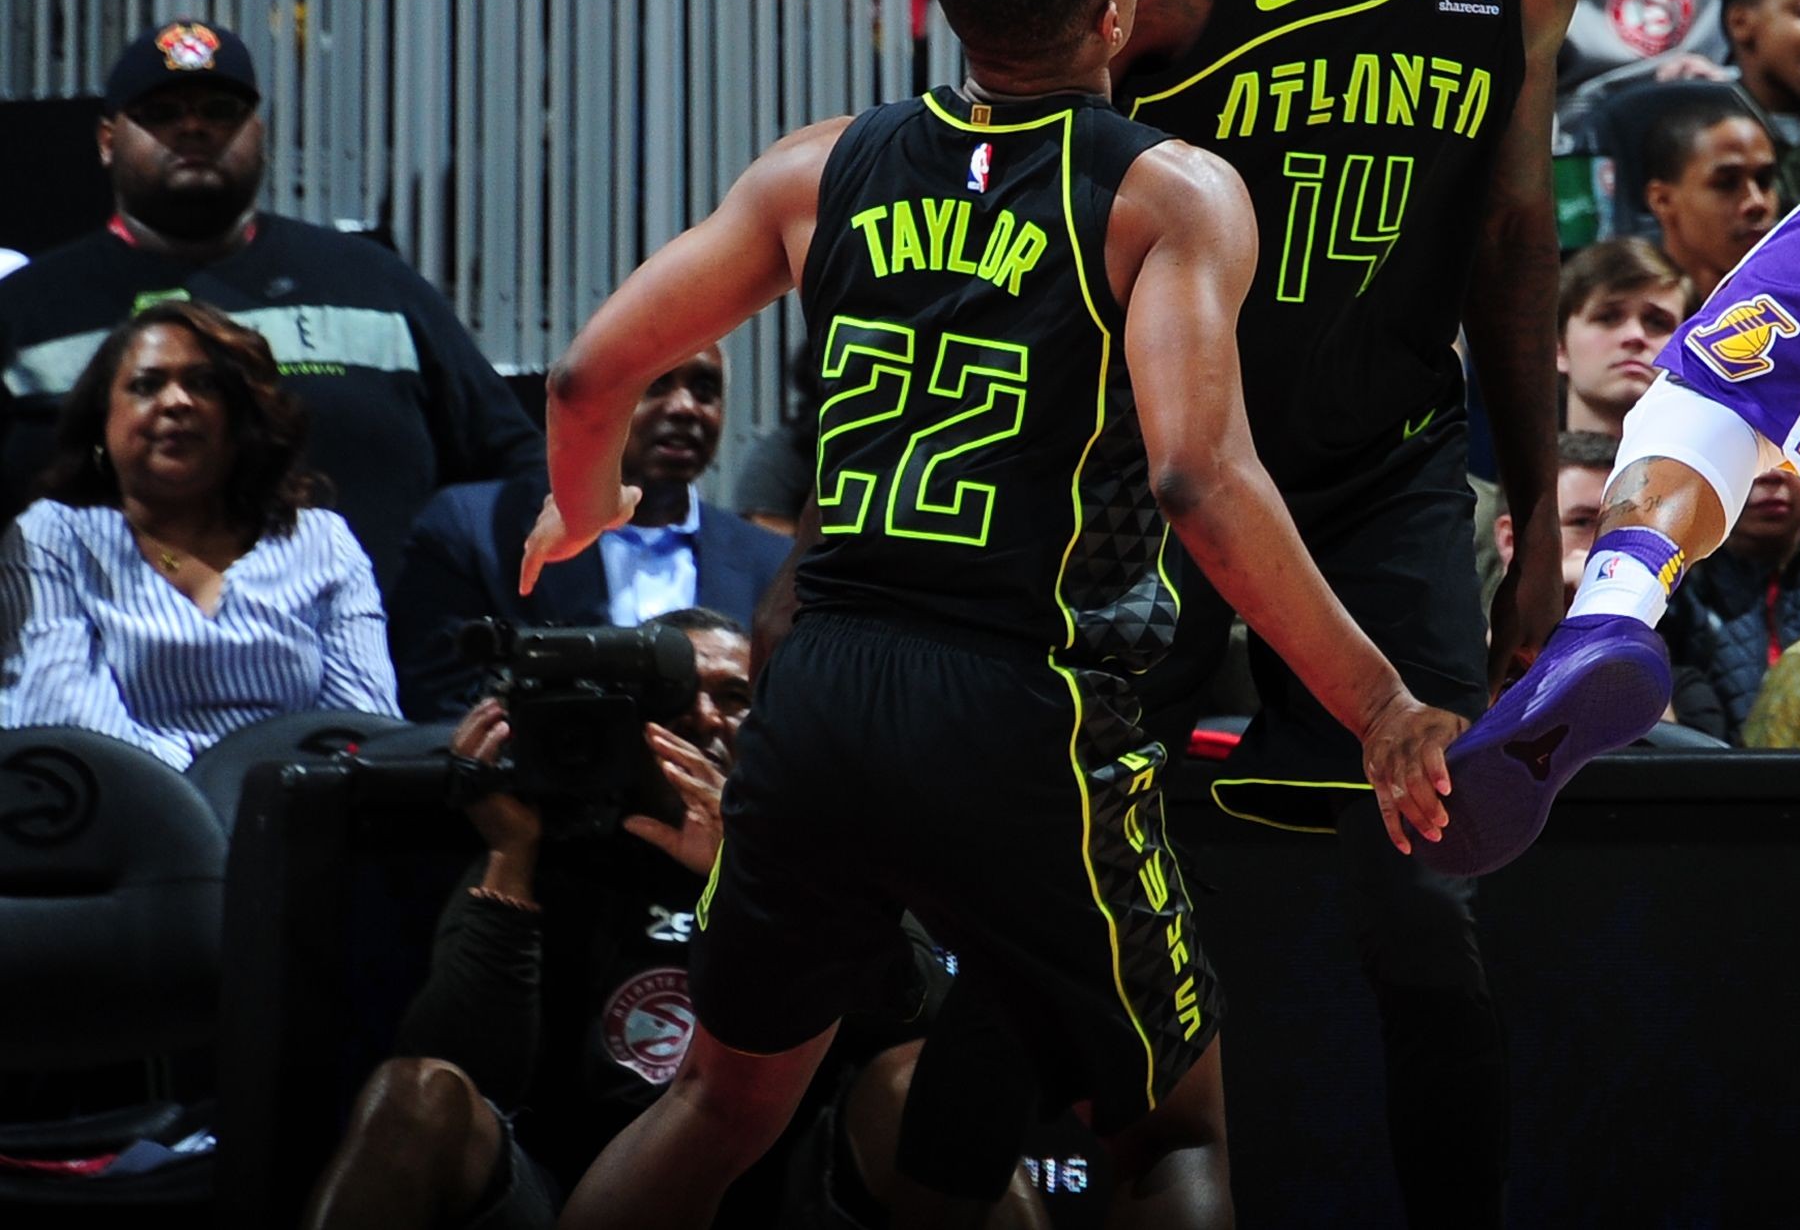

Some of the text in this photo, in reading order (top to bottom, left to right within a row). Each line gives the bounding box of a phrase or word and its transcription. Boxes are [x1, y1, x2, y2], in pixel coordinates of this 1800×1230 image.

[1215, 52, 1492, 140] ATLANTA
[850, 198, 1049, 297] TAYLOR
[1276, 151, 1415, 303] 14
[816, 315, 1029, 547] 22
